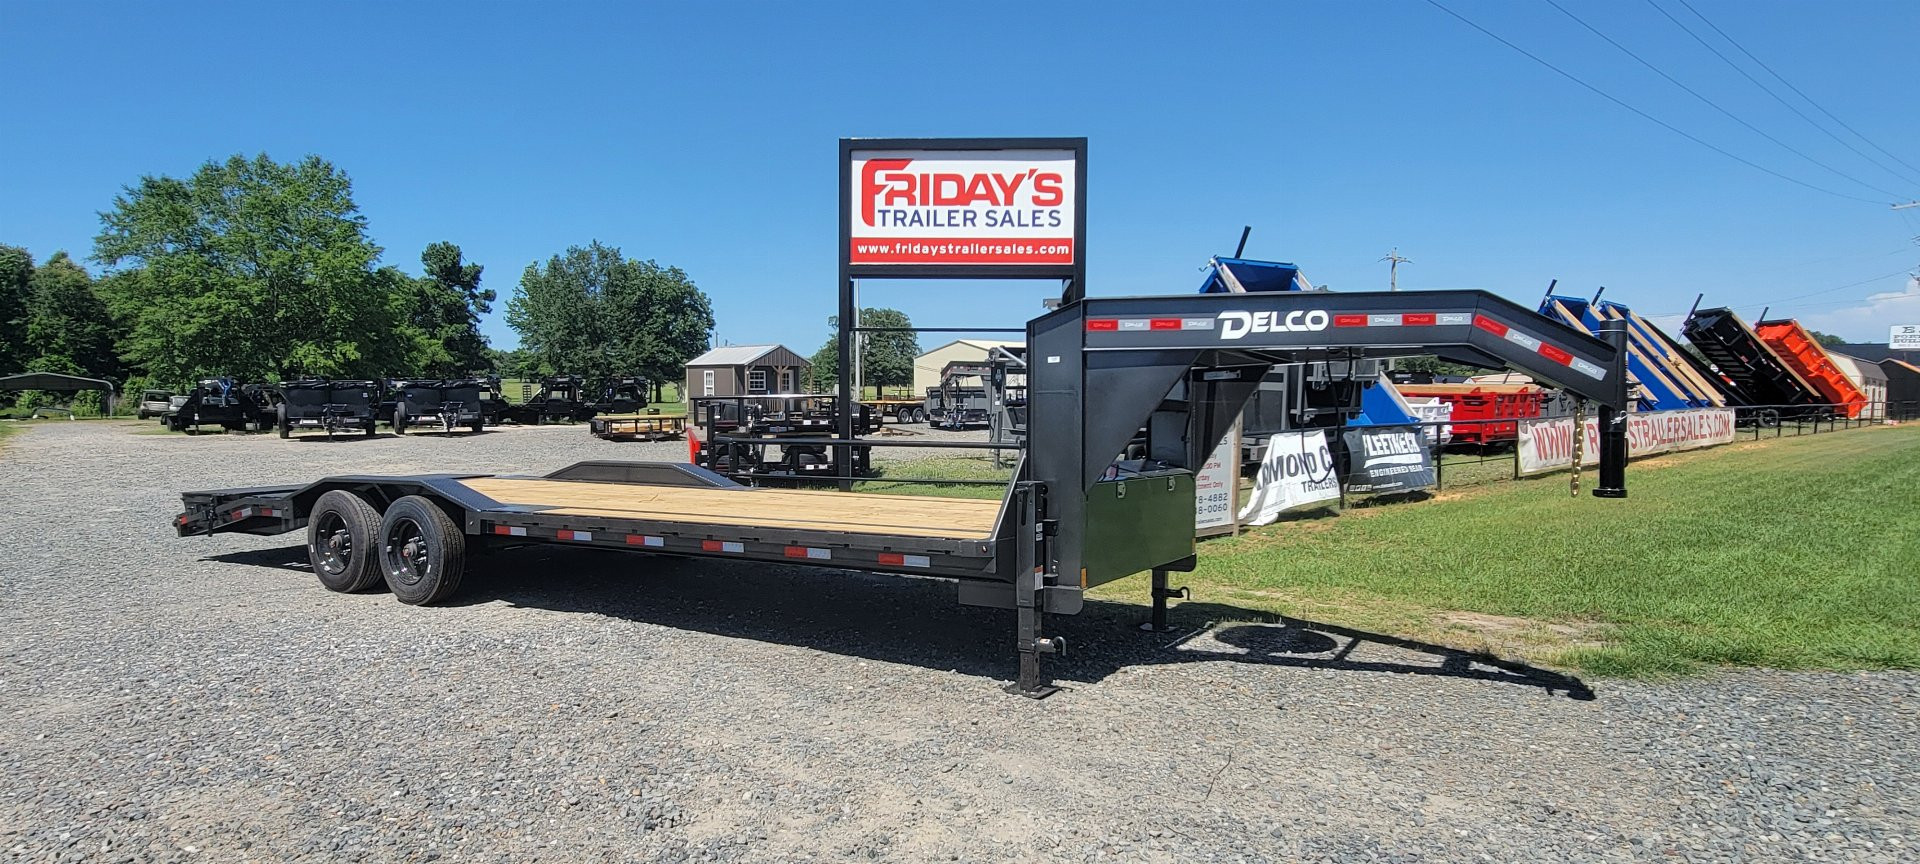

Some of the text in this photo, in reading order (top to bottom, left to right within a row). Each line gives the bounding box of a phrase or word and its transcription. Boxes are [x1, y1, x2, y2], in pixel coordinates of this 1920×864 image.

[861, 158, 1064, 227] FRIDAY'S
[878, 209, 1062, 227] TRAILER SALES
[857, 243, 1069, 256] www.fridaystrailersales.com
[1217, 309, 1330, 340] DELCO
[1301, 477, 1338, 493] TRAILERS
